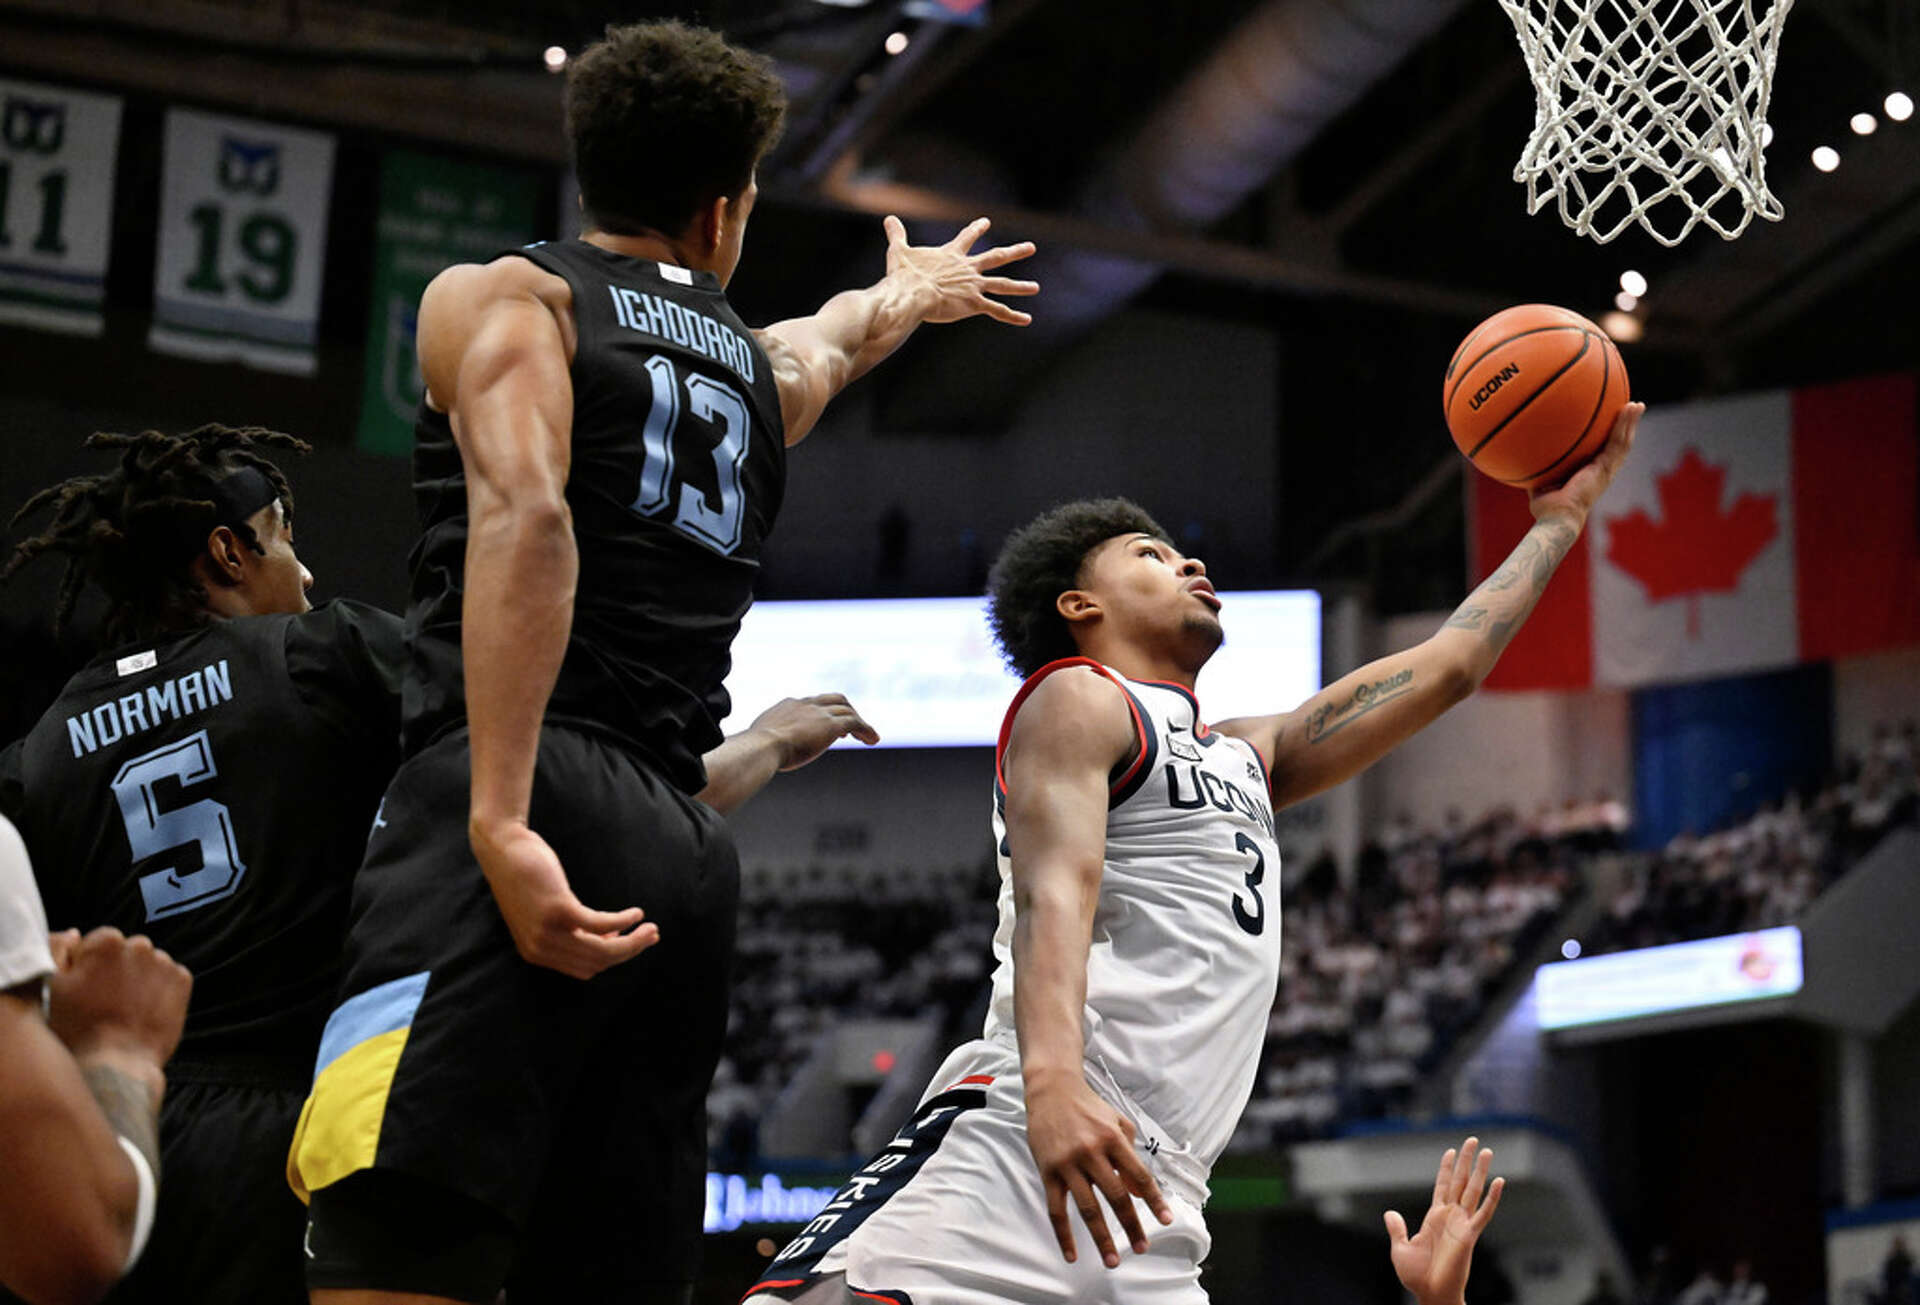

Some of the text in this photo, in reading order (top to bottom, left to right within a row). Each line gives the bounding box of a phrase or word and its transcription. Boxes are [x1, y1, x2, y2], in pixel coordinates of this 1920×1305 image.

[184, 203, 298, 303] 19
[607, 285, 755, 385] IGHODARO
[1468, 361, 1520, 411] UCONN
[629, 354, 750, 556] 13
[66, 660, 233, 758] NORMAN
[110, 729, 247, 924] 5
[1232, 832, 1265, 937] 3
